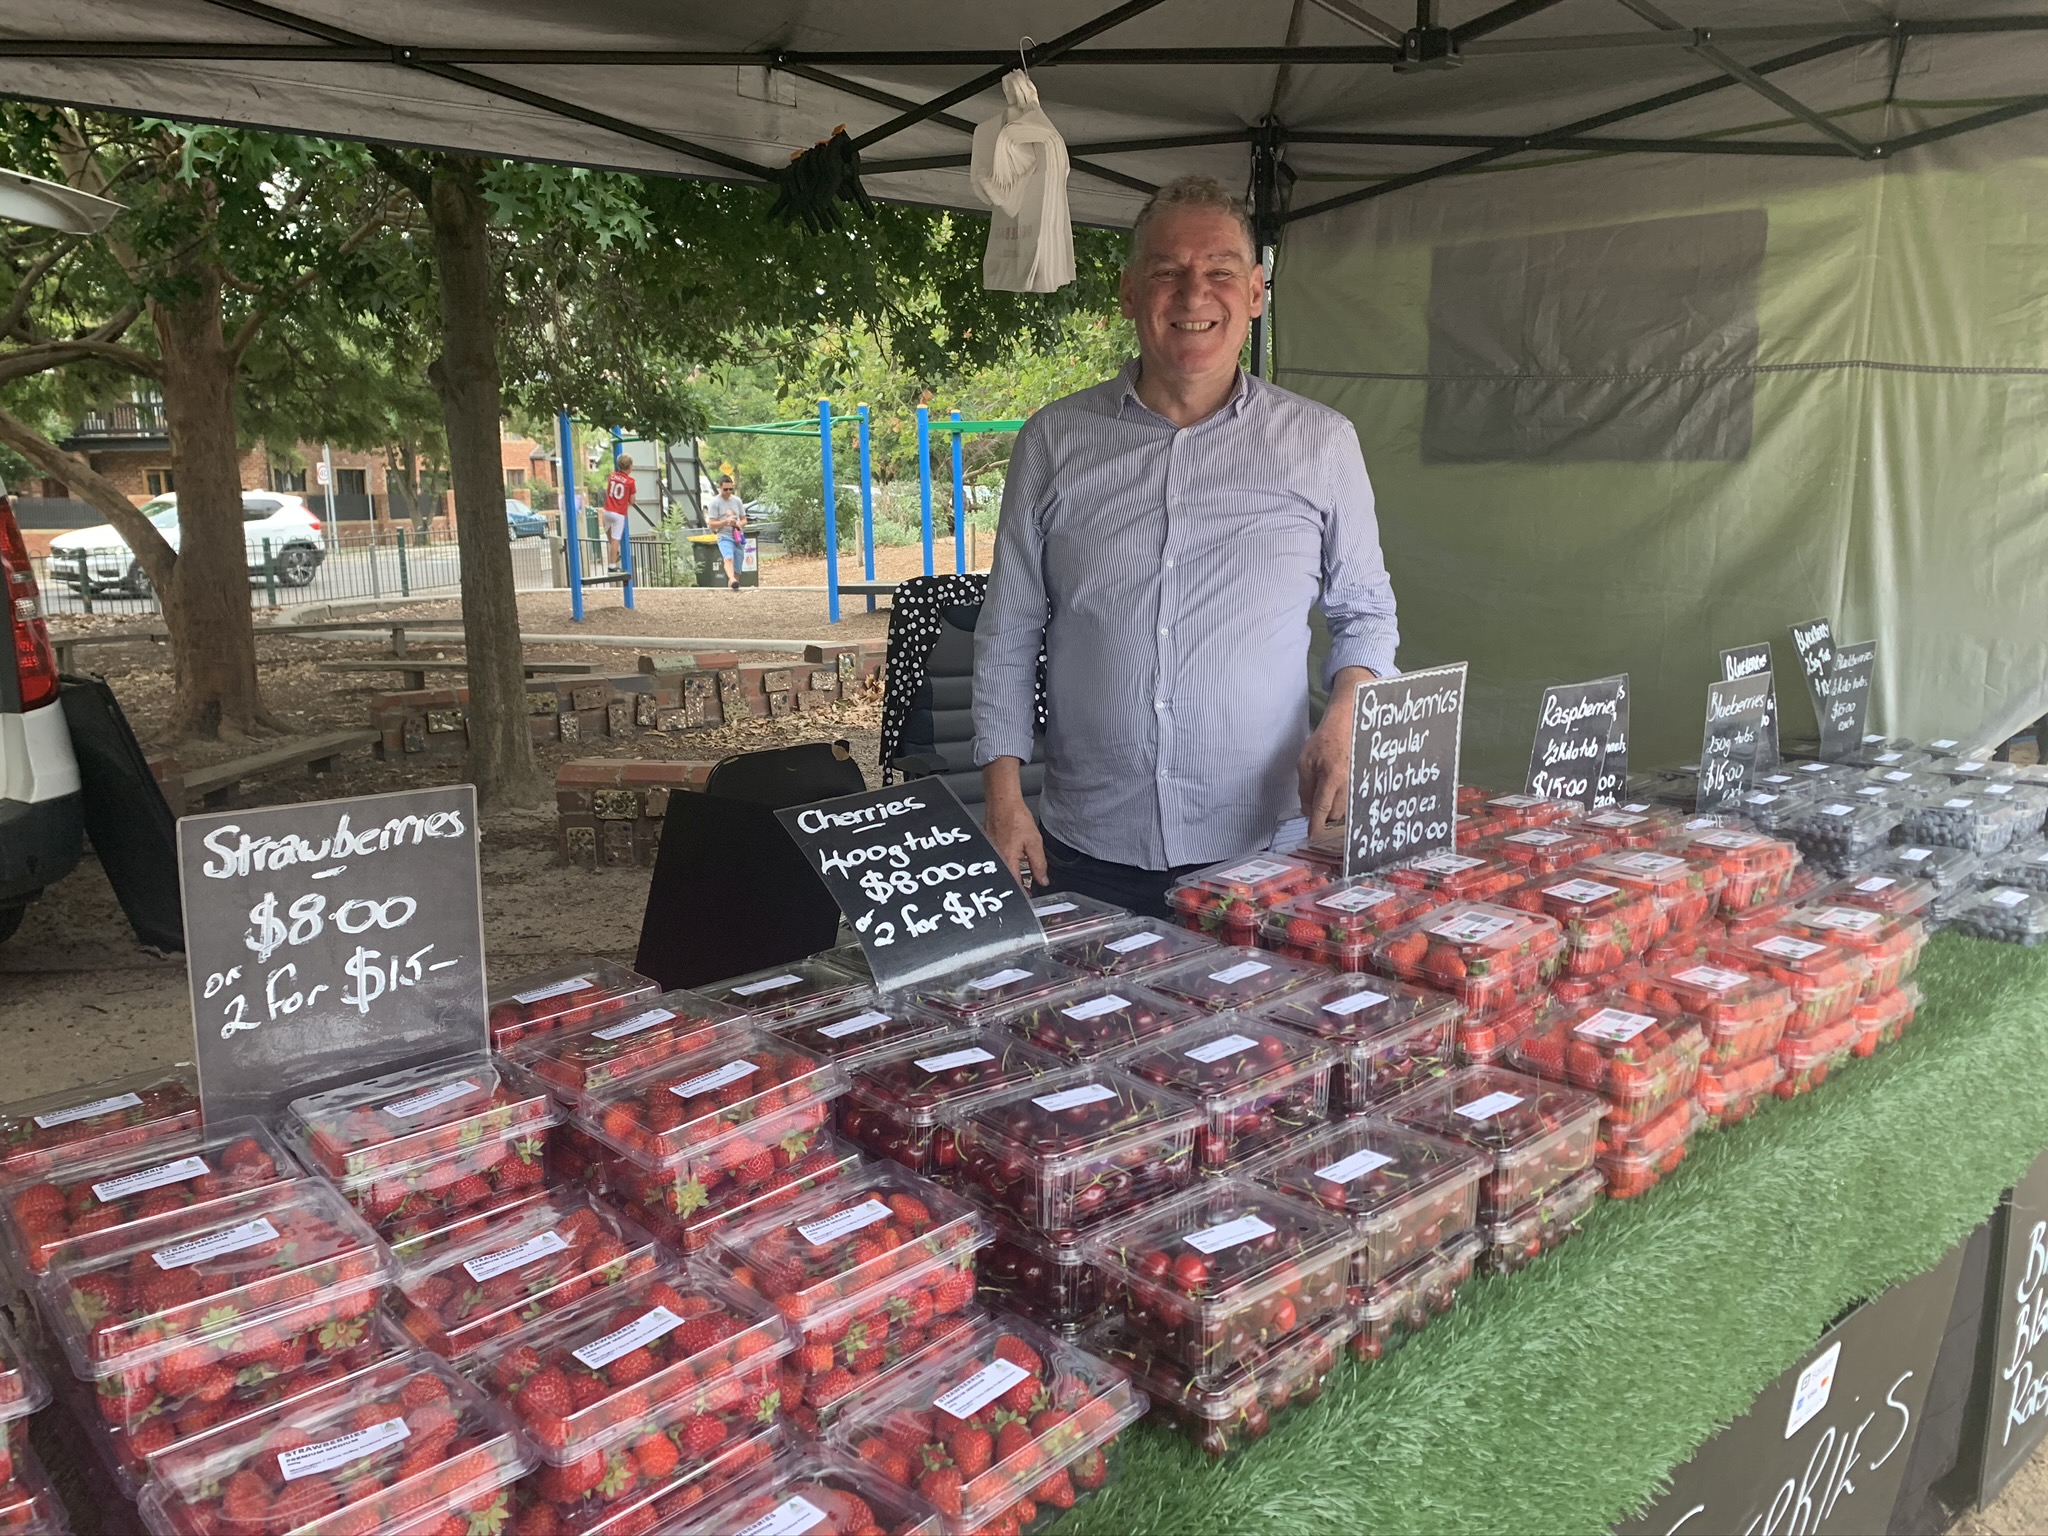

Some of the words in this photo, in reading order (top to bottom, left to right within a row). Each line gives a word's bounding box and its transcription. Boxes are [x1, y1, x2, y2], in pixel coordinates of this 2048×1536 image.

[610, 481, 625, 500] 10
[1360, 686, 1459, 731] Strawberries
[1708, 691, 1765, 722] Blueberries
[1369, 727, 1430, 765] Regular
[1405, 758, 1441, 789] tubs
[797, 796, 926, 834] Cherries
[203, 811, 465, 879] Strawberries
[1358, 834, 1368, 859] 2
[1371, 828, 1391, 857] for
[874, 922, 895, 947] 2
[901, 903, 943, 937] for
[220, 994, 262, 1039] 2
[284, 1430, 367, 1457] STRAWBERRIES
